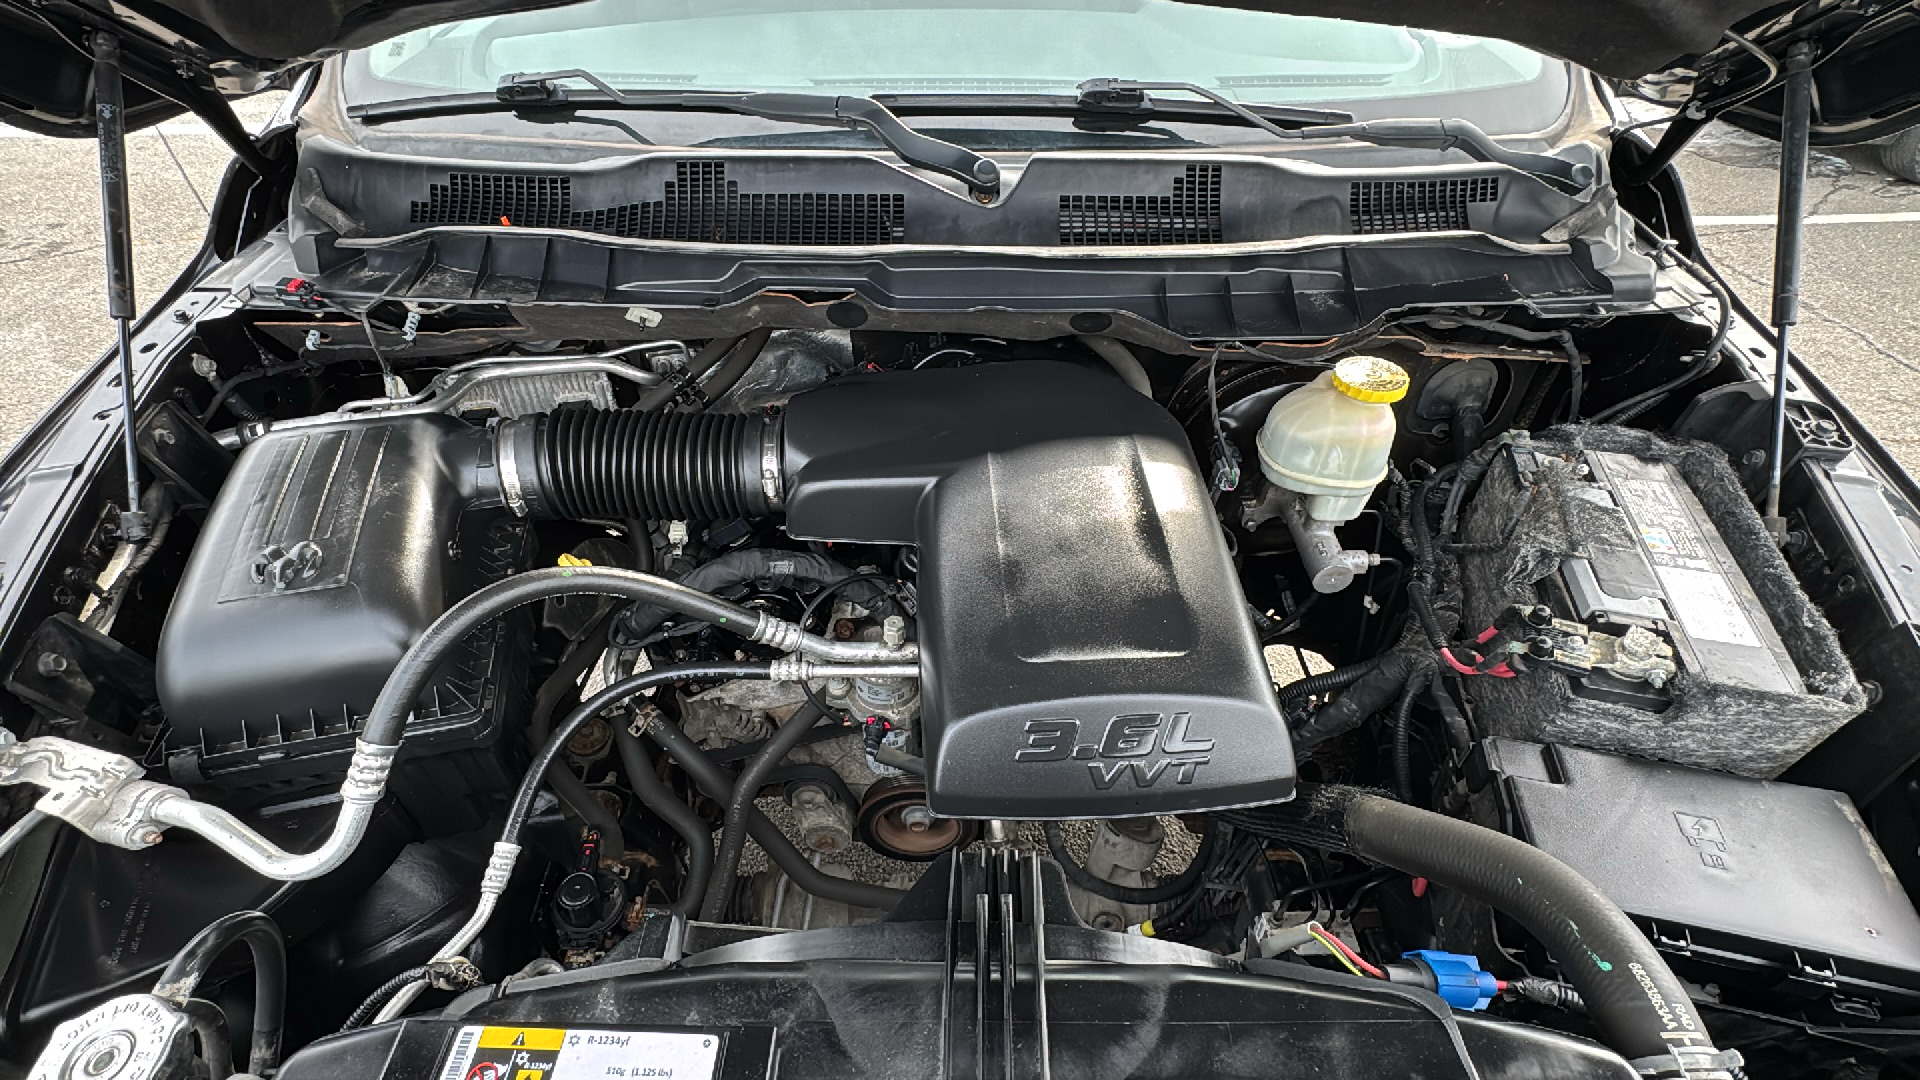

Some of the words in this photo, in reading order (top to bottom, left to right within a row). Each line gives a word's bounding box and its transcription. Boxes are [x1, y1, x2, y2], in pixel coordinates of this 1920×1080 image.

[1015, 711, 1216, 762] 3.6L
[1088, 755, 1211, 790] VVT
[1671, 1003, 1695, 1031] RAD
[587, 1035, 631, 1047] R-1234yf
[657, 1068, 673, 1079] lbs)
